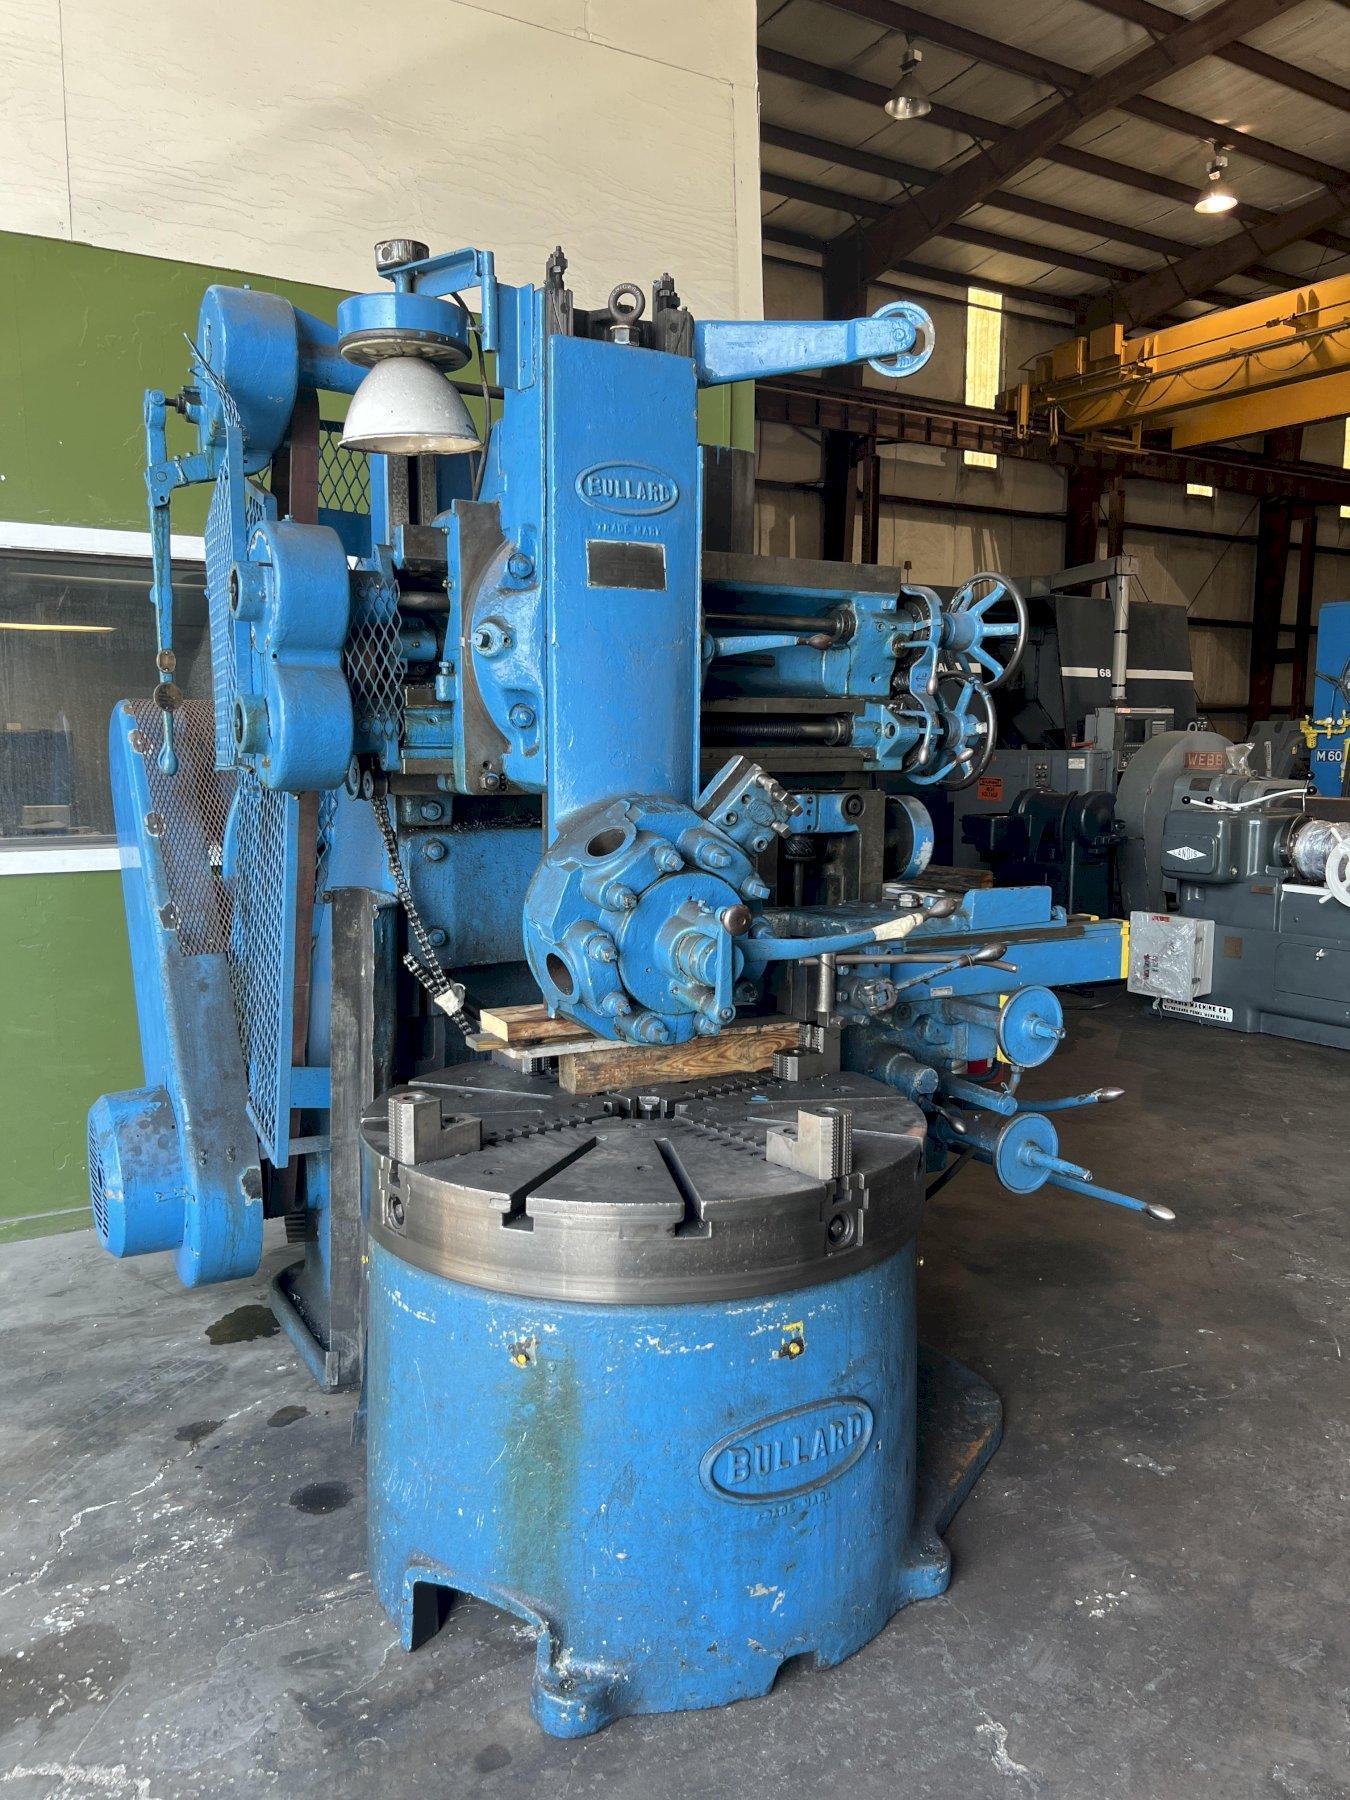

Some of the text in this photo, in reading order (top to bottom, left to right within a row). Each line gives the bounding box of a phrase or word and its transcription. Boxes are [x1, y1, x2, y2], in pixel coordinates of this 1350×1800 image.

[587, 476, 670, 502] BULLARD
[1099, 668, 1112, 678] 68
[1187, 753, 1223, 766] WEBB
[726, 1413, 864, 1485] BULLARD
